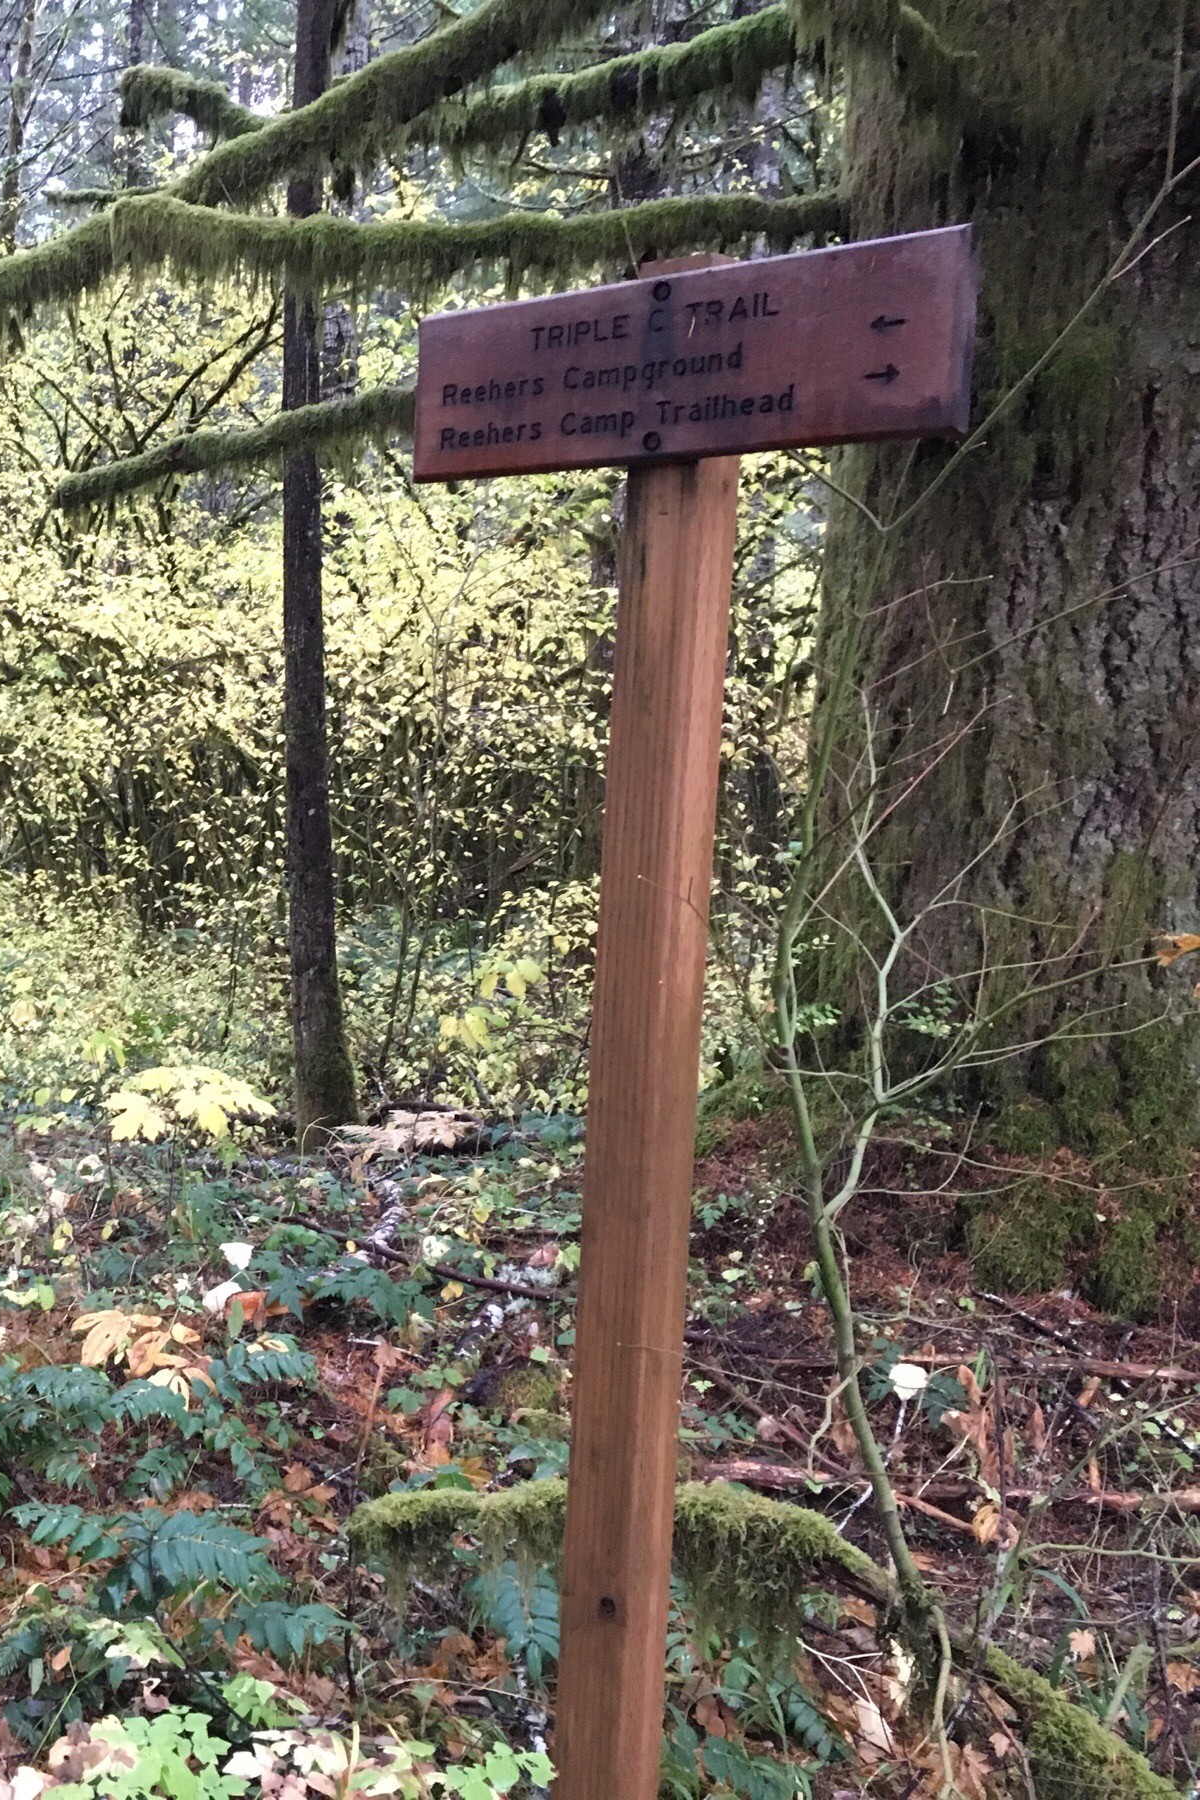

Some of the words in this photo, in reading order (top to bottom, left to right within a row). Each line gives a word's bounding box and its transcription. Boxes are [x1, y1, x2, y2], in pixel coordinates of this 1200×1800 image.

[531, 314, 629, 352] TRIPLE
[648, 308, 665, 334] C
[685, 292, 780, 328] TRAIL
[442, 374, 544, 406] Reehers
[563, 342, 744, 391] Campground
[440, 422, 541, 451] Reehers
[560, 410, 635, 440] Camp
[657, 384, 794, 425] Trailhead
